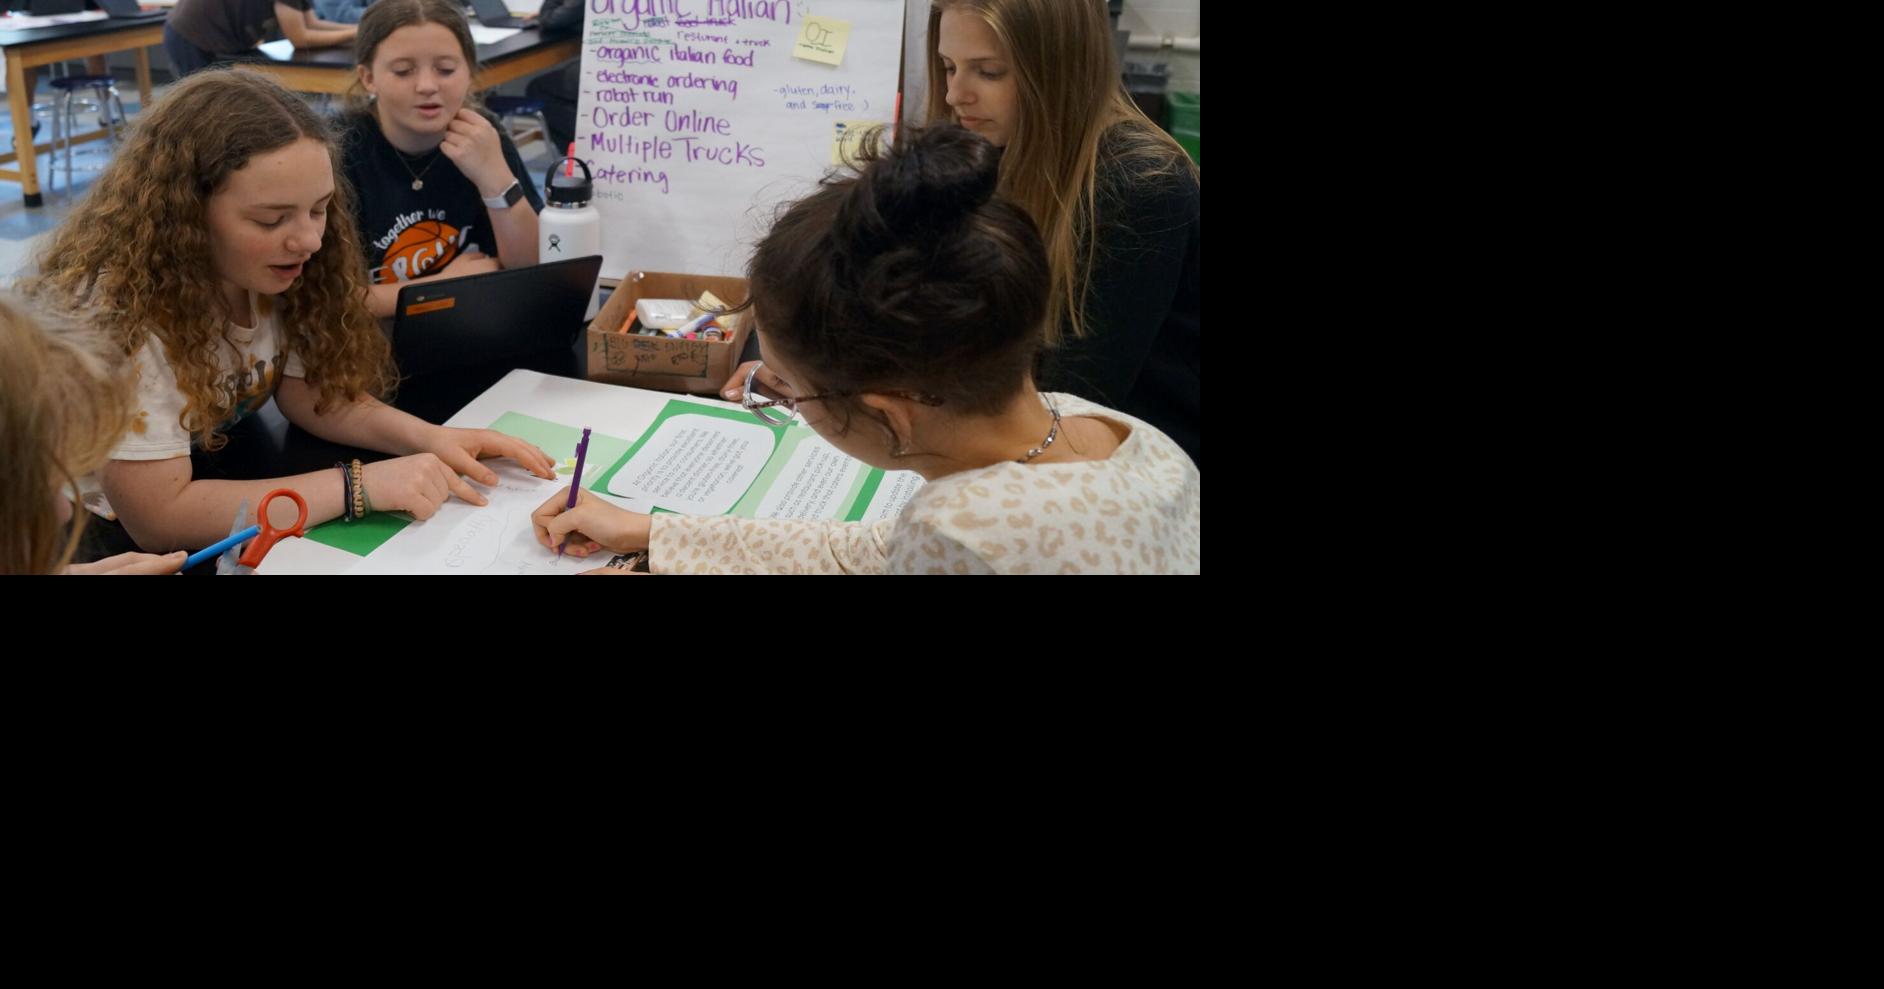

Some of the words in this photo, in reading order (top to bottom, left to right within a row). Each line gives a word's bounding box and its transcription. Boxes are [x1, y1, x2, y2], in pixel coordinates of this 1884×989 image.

[723, 48, 754, 67] food
[596, 89, 640, 104] robot
[643, 90, 674, 105] run
[667, 74, 737, 100] ordering
[592, 106, 655, 129] Order
[664, 110, 731, 136] Online
[590, 132, 672, 163] Multiple
[372, 209, 424, 250] together
